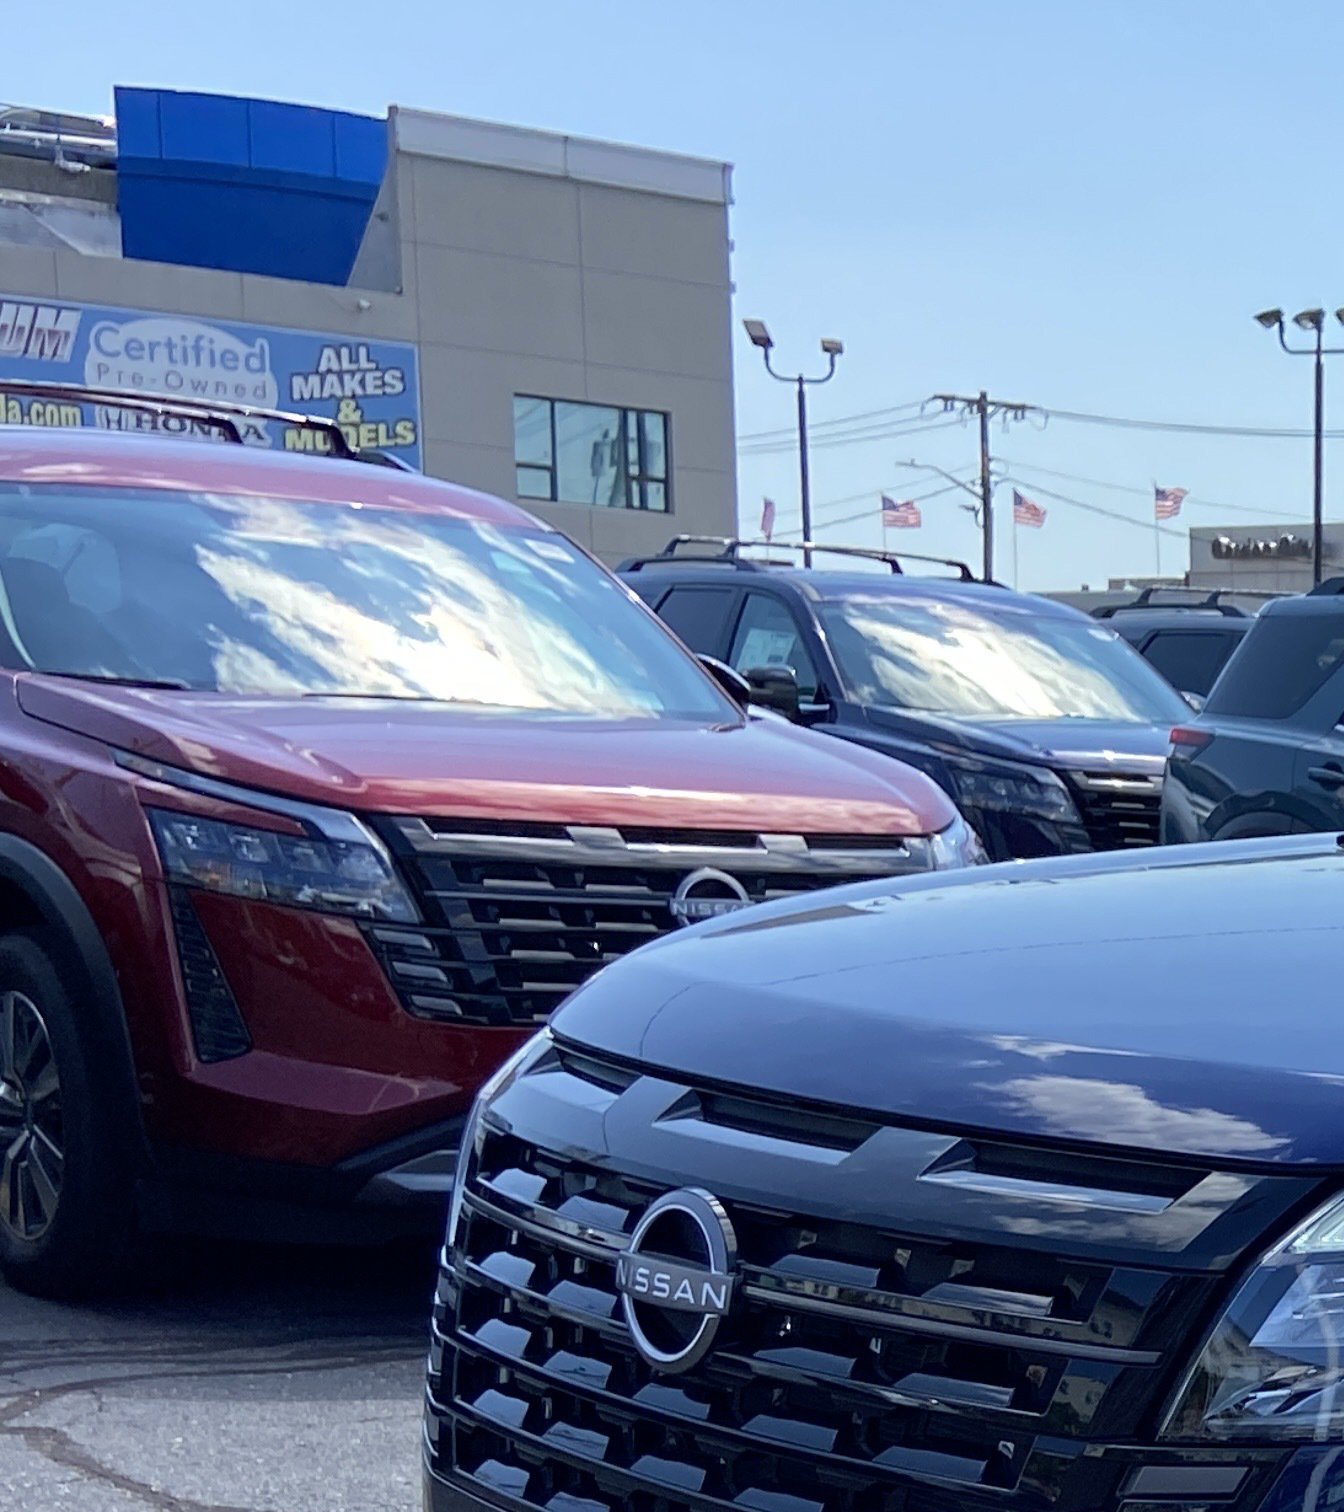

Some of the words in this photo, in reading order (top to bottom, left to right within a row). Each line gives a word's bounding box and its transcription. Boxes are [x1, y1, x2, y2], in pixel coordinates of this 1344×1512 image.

[94, 325, 267, 374] Certified
[318, 344, 377, 373] ALL
[97, 362, 267, 400] Pre-Owned
[290, 368, 405, 401] MAKES
[337, 398, 362, 425] &
[672, 902, 750, 916] NISSA
[617, 1258, 726, 1309] NISSAN
